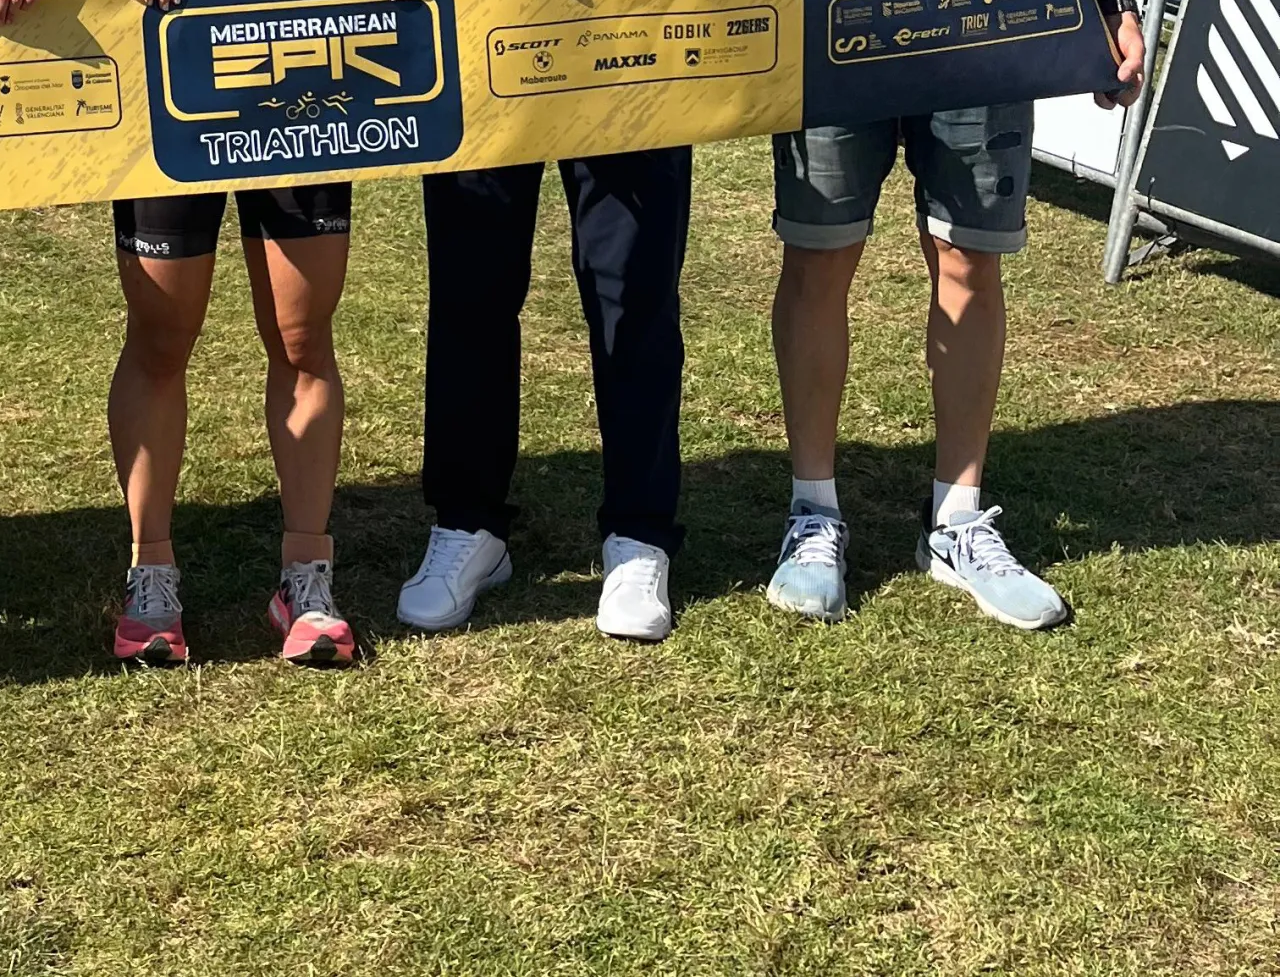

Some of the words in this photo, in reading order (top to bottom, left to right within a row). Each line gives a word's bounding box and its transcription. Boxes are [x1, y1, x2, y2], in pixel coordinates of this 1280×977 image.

[210, 12, 397, 44] MEDITERRANEAN
[663, 23, 712, 40] GOBIK
[961, 13, 990, 34] TRICV
[593, 30, 648, 41] PANAMA
[507, 38, 563, 51] SCOTT
[594, 53, 657, 71] MAXXIS
[520, 73, 567, 85] Maberauto
[200, 116, 419, 165] TRIATHLON
